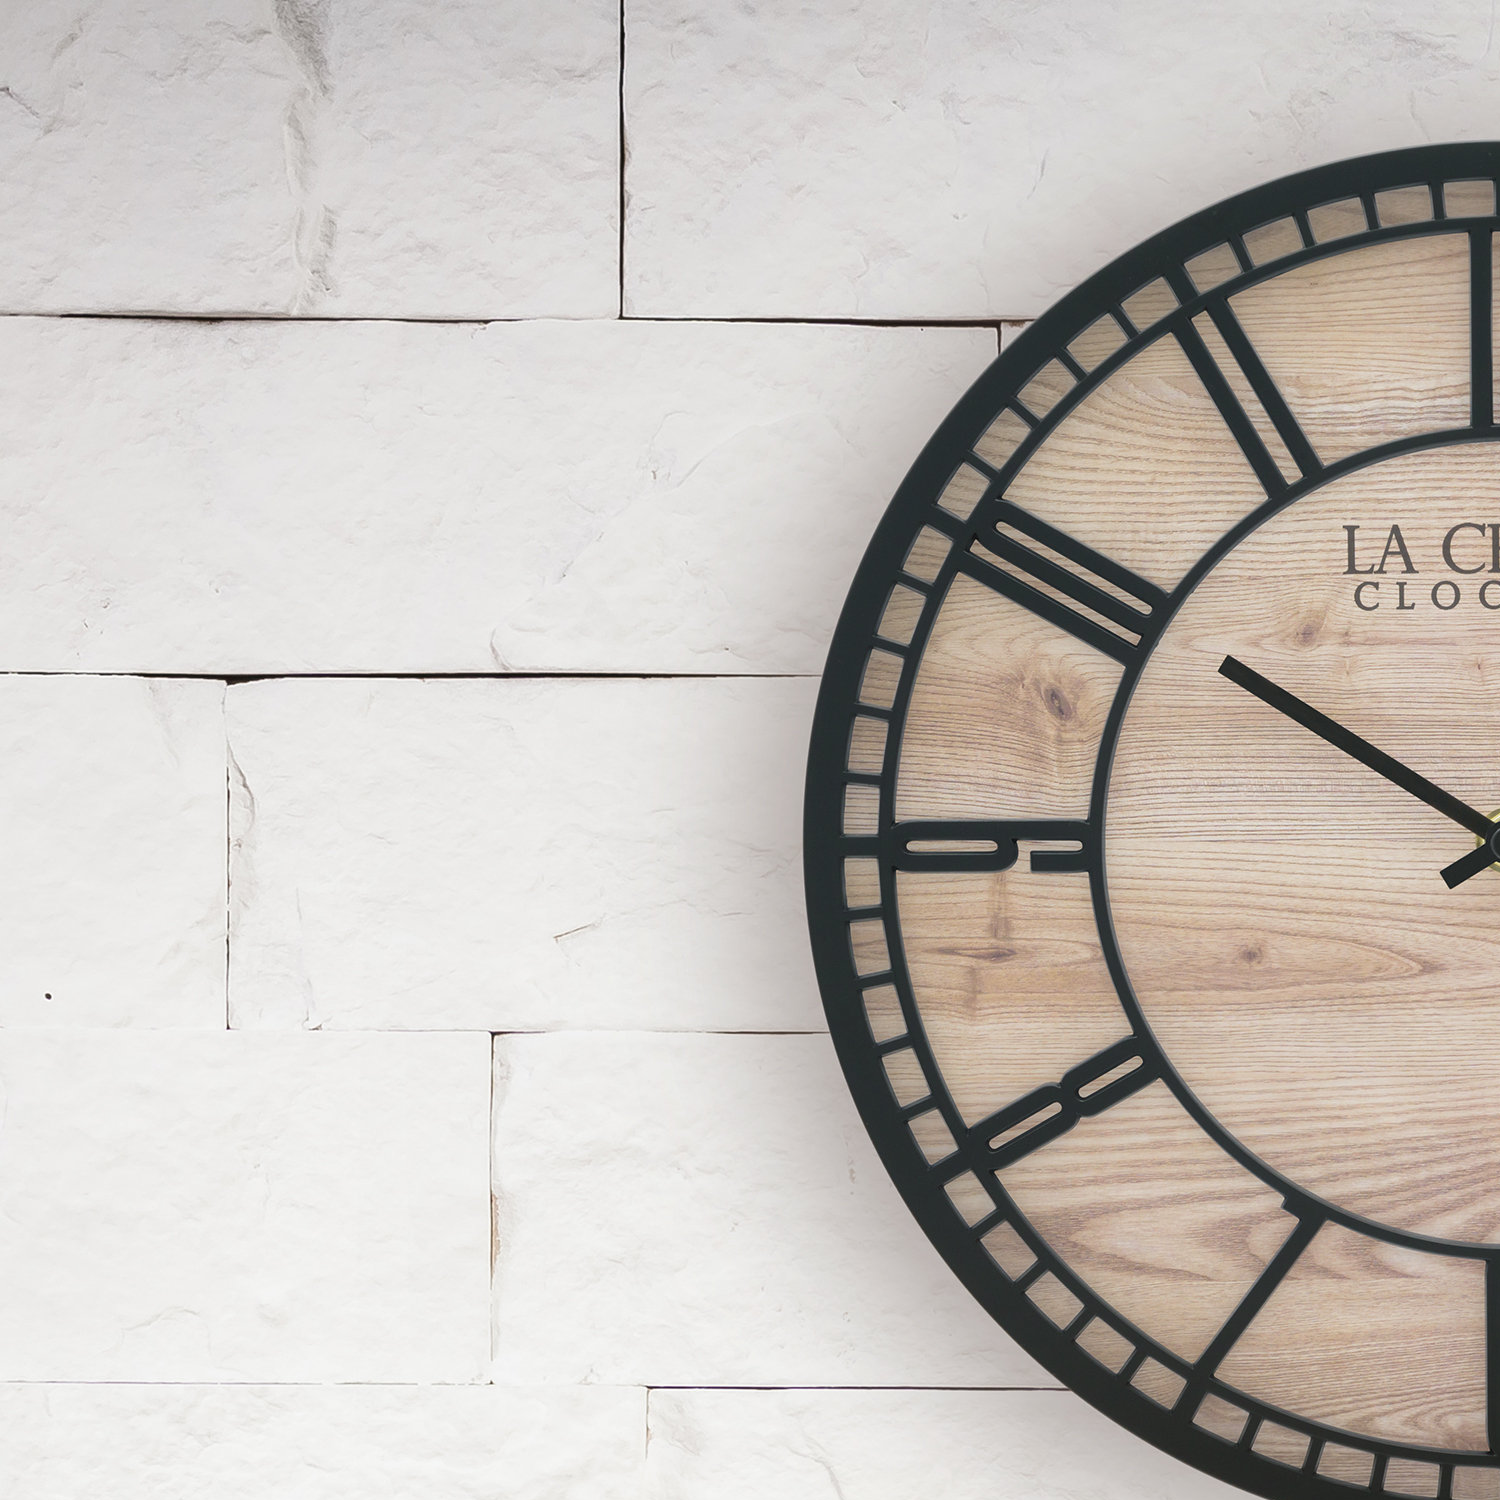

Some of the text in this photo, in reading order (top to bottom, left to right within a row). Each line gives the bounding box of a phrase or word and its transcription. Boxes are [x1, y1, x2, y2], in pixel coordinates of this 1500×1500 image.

[1170, 299, 1325, 498] 11
[958, 498, 1172, 667] 10
[1342, 524, 1419, 576] LA
[893, 819, 1092, 874] 9
[965, 1035, 1162, 1173] 8
